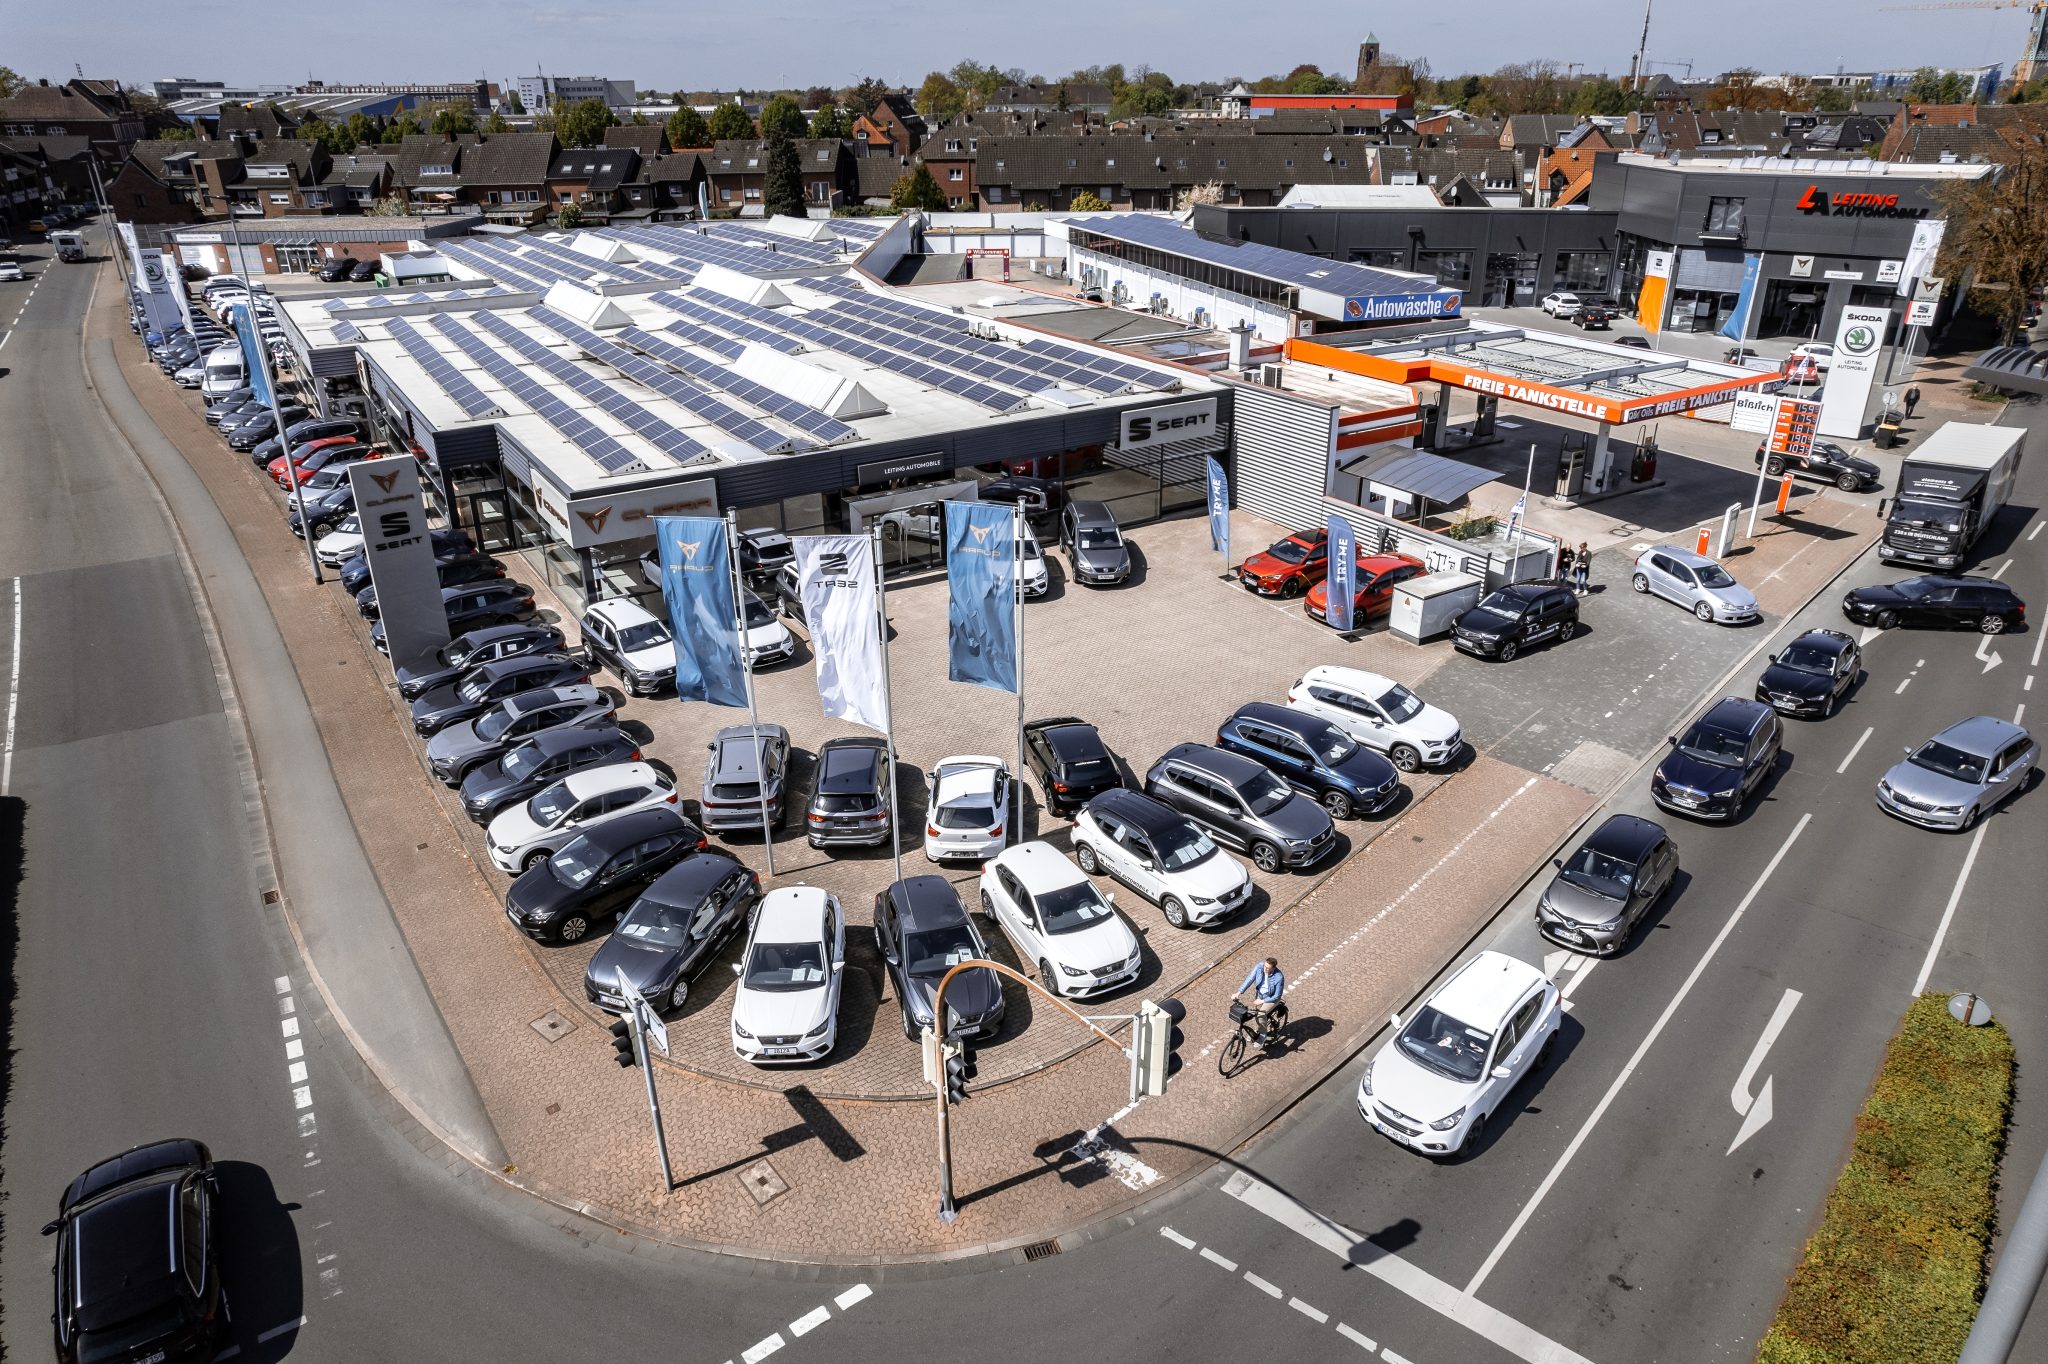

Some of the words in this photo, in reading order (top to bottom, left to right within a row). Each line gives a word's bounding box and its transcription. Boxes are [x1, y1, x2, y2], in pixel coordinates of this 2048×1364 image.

[1831, 193, 1899, 207] LEITING
[1832, 205, 1930, 220] AUTOMOBILE
[1364, 295, 1442, 319] Autowäsche
[1847, 313, 1883, 323] ŠKODA
[1837, 364, 1868, 372] AUTOMOBILE
[1463, 374, 1505, 395] FREIE
[1507, 384, 1608, 420] TANKSTELLE
[1655, 397, 1687, 416] FREIE
[1736, 399, 1774, 412] Bißlich
[1157, 413, 1210, 431] SEAT
[884, 465, 905, 475] LEITING
[906, 460, 941, 471] AUTOMOBILE
[375, 536, 423, 552] SEAT
